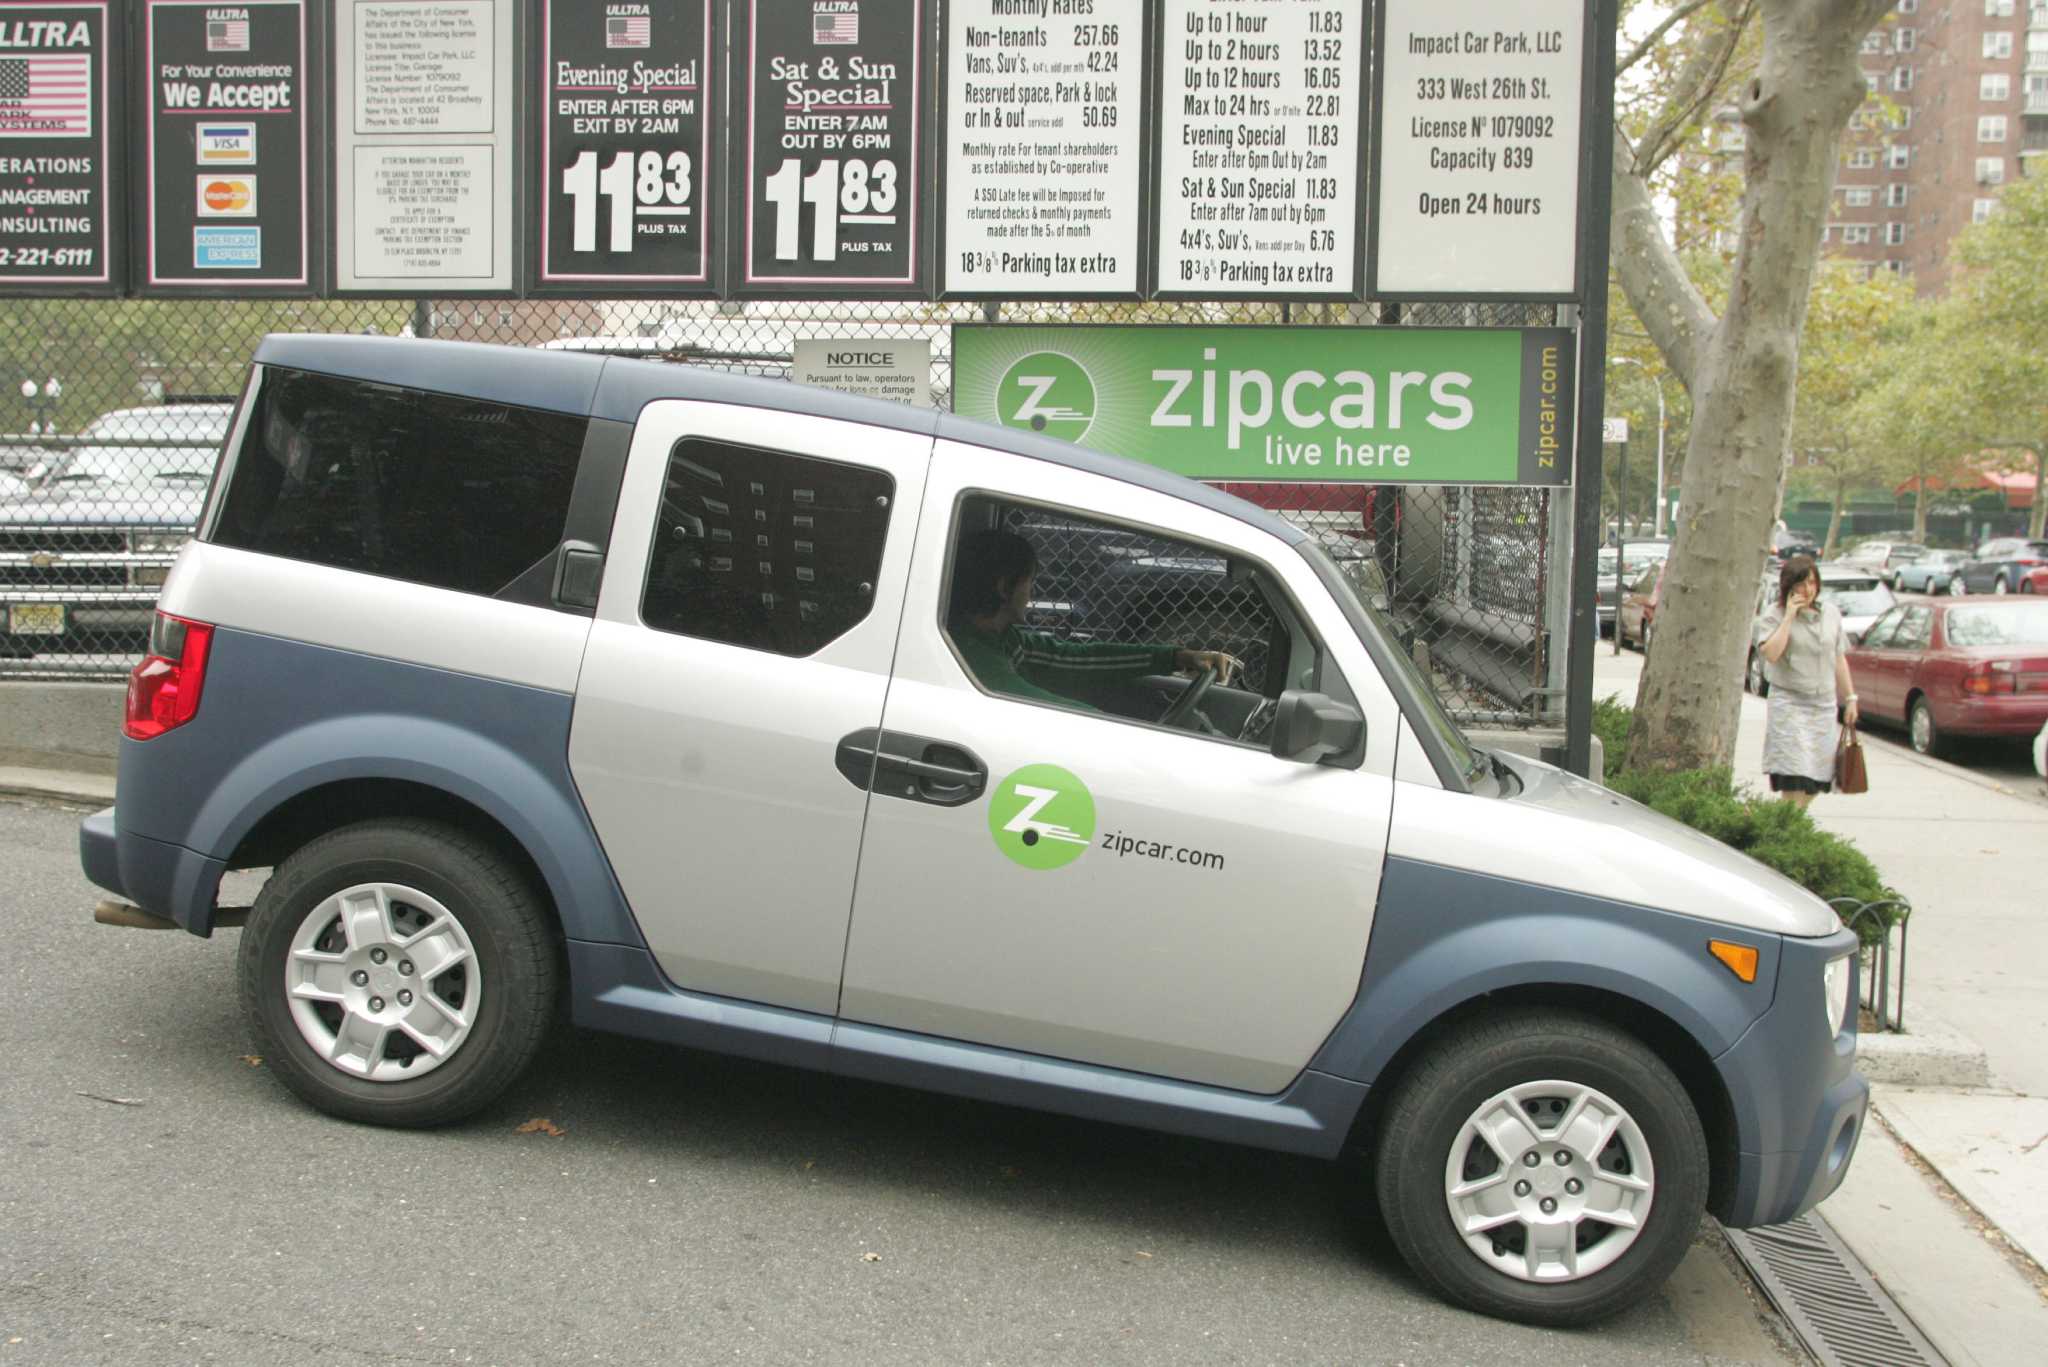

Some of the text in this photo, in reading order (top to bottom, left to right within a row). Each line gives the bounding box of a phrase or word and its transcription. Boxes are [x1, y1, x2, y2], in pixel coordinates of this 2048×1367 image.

[206, 9, 249, 20] ULLTRA
[606, 4, 650, 16] ULLTRA
[814, 1, 858, 12] ULLTRA
[992, 0, 1093, 18] Monthly Rates
[0, 21, 91, 47] LLTRA
[1187, 11, 1342, 36] Up to hour 11.83
[966, 25, 1118, 47] Non-tenants 257.66
[1409, 31, 1562, 57] Impact Car Park, LLC
[1186, 40, 1341, 64] Up to hours 13.52
[162, 64, 292, 77] For Your Convenience
[771, 58, 896, 81] Sat Sun
[966, 52, 1118, 74] Vans, 42.24
[557, 60, 696, 93] Evening Special
[1185, 67, 1340, 91] Up to 12 hours 16.05
[163, 81, 290, 110] We Accept
[786, 81, 890, 112] Special
[966, 82, 1117, 103] Reserved Park lock
[1417, 78, 1550, 99] 333 West 26th St.
[559, 101, 694, 114] ENTER AFTER 6PM
[1184, 95, 1339, 116] Max to 24 hrs 22.81
[0, 120, 67, 129] YSTEMS
[574, 119, 678, 133] EXIT BY 2AM
[785, 117, 887, 131] ENTER 7AM
[965, 112, 976, 128] or
[1007, 108, 1025, 128] out
[1083, 106, 1117, 127] 50.69
[1412, 116, 1553, 138] License 1079092
[213, 138, 240, 149] VISA
[782, 135, 890, 149] OUT BY 6PM
[1184, 124, 1338, 149] Evening Special 11.83
[963, 143, 1118, 157] Monthly rate For tenant shareholders
[1193, 150, 1326, 171] Enter after 6pm Out by 2am
[1431, 147, 1533, 172] Capacity 839
[0, 157, 91, 173] ERATIONS
[984, 160, 1108, 176] established by Co-operative
[1032, 189, 1045, 201] will
[1182, 177, 1336, 201] Sat Sun Special 11.83
[967, 207, 1111, 221] returned checks monthly payments
[1191, 203, 1325, 225] Enter after 7am out by 6pm
[1419, 193, 1541, 217] Open 24 hours
[638, 225, 686, 233] PLUS TAX
[987, 225, 1090, 237] made after the month
[842, 243, 892, 252] PLUS TAX
[1310, 230, 1335, 251] 6.76
[0, 247, 93, 265] 2-221-6111
[1002, 253, 1116, 277] Parking tax extra
[1220, 261, 1333, 285] Parking tax extra
[827, 353, 894, 365] NOTICE
[807, 374, 915, 384] Pursuant law, operators
[882, 386, 915, 395] damage
[1151, 348, 1474, 450] zipcars
[1534, 346, 1559, 469] zipcar.com
[1266, 435, 1411, 466] live here
[1102, 830, 1224, 870] zipcar.com
